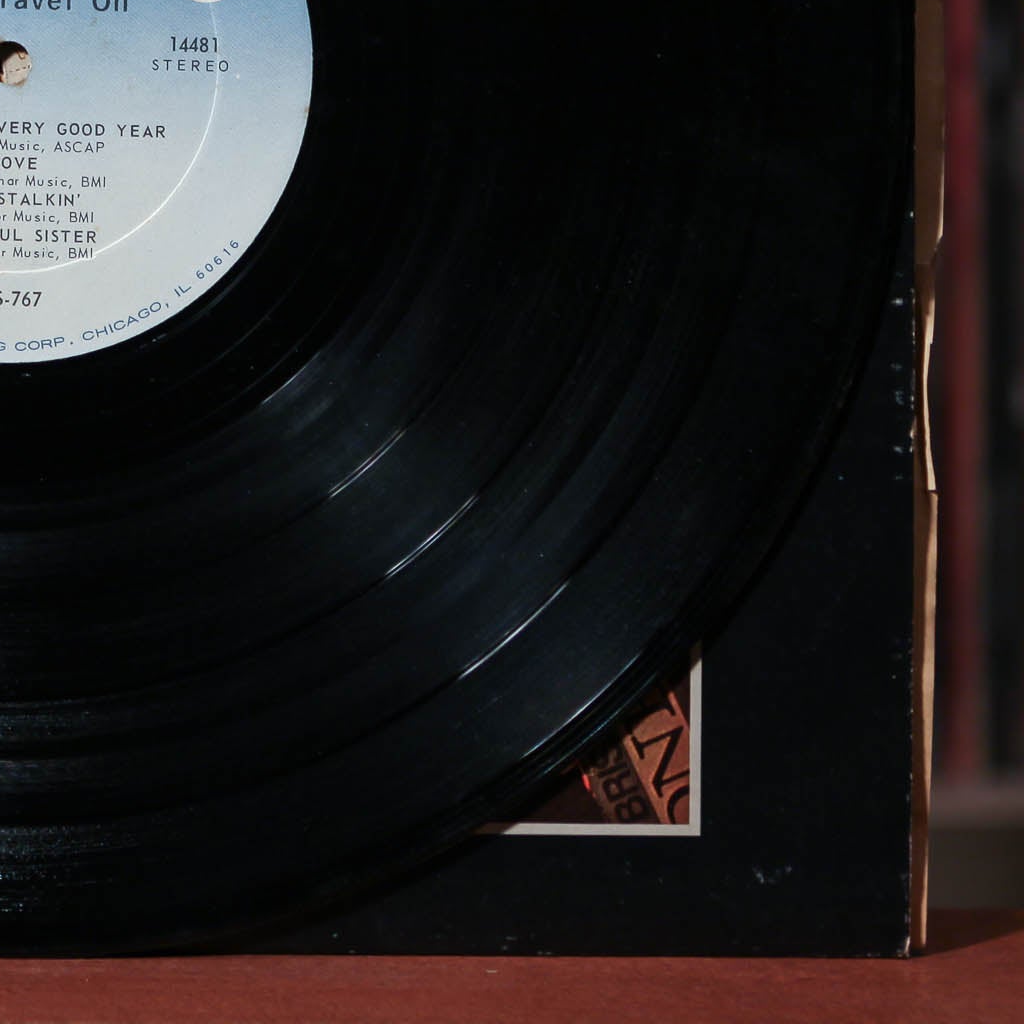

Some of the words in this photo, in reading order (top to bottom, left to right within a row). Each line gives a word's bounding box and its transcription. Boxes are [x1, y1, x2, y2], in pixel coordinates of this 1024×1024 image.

[170, 35, 218, 53] 14481
[151, 58, 229, 73] STEREO
[56, 122, 106, 137] GOOD
[116, 123, 166, 139] YEAR
[53, 140, 105, 154] ASCAP
[25, 174, 72, 190] Music,
[81, 175, 106, 188] BMI
[13, 209, 60, 225] Music,
[69, 211, 94, 224] BMI
[34, 228, 97, 244] SISTER
[12, 246, 60, 262] Music,
[68, 247, 93, 260] BMI
[82, 301, 170, 341] CHICAGO,
[174, 284, 192, 297] IL
[195, 239, 240, 280] 60616
